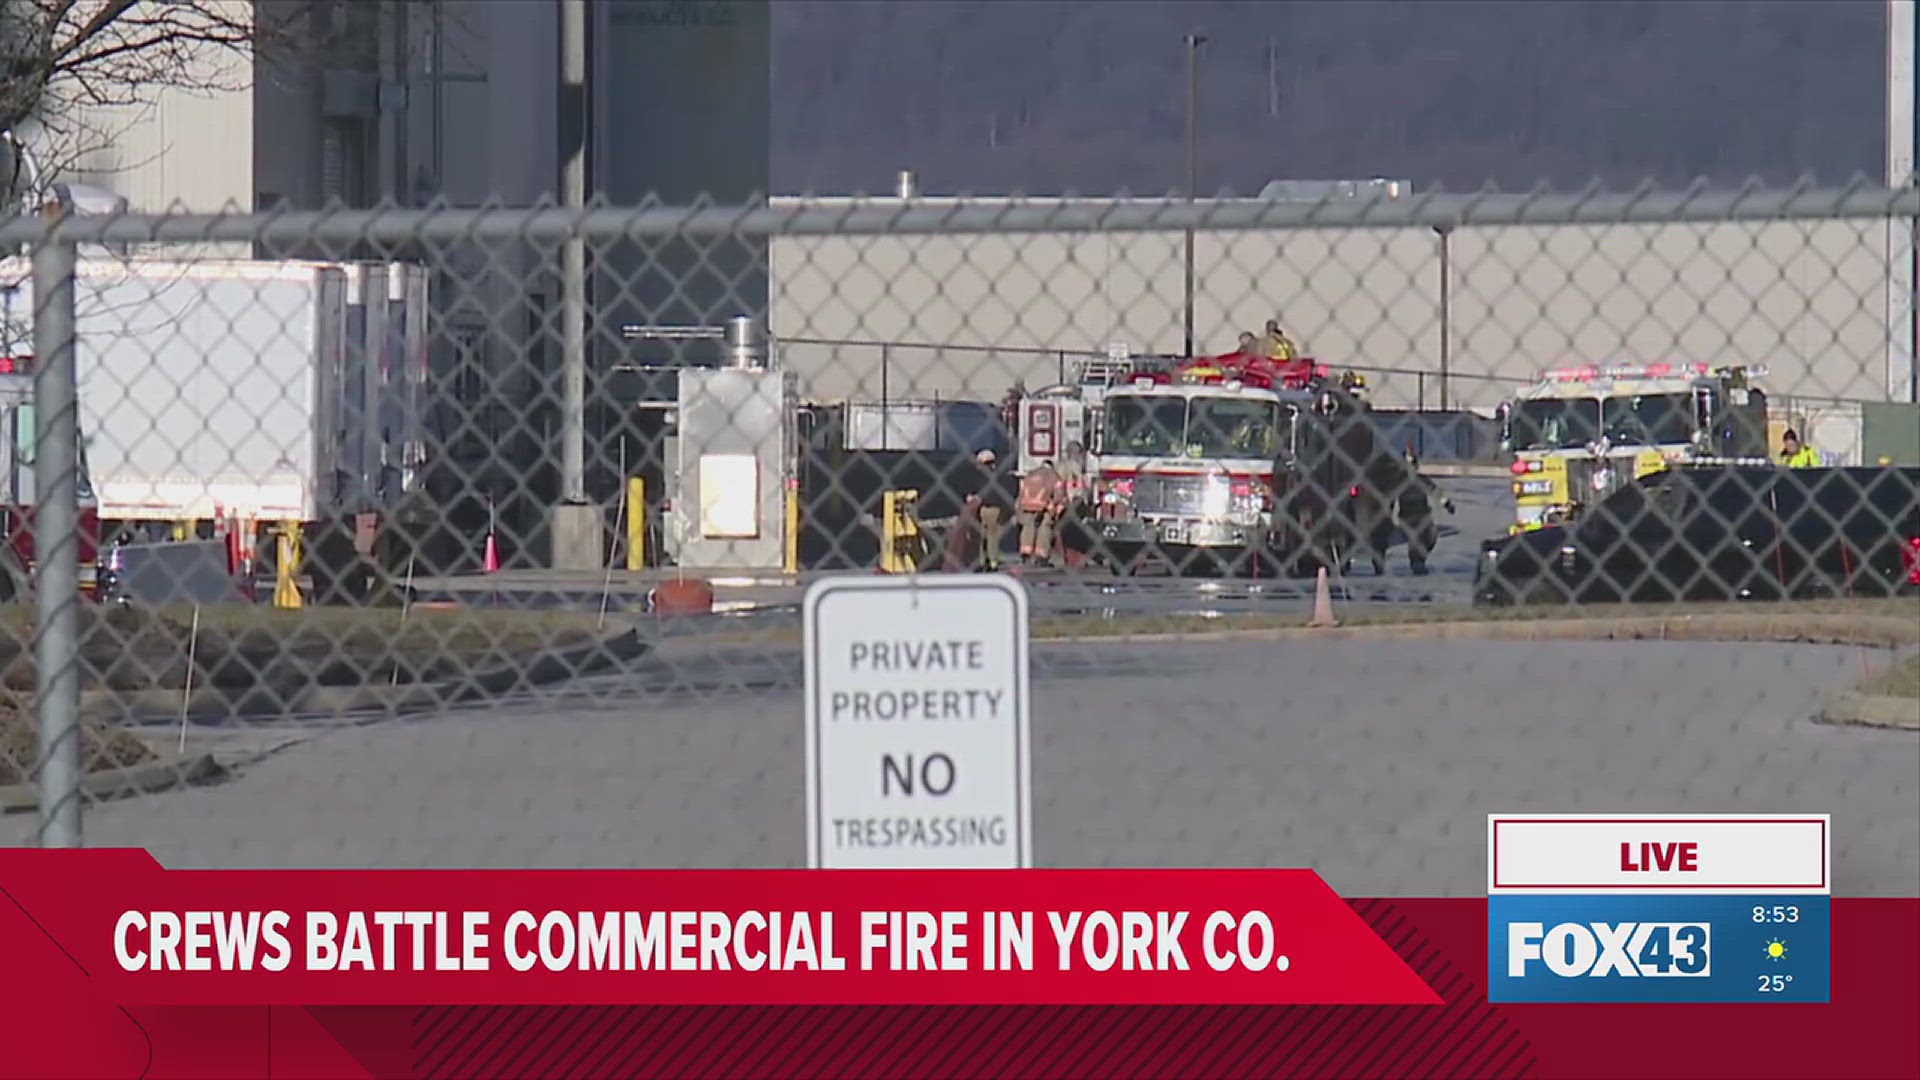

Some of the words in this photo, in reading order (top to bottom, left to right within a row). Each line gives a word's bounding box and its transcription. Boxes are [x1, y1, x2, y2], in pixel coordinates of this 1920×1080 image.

[850, 640, 984, 670] PRIVATE
[832, 689, 1003, 720] PROPERTY
[881, 752, 956, 797] NO
[832, 817, 1007, 848] TRESPASSING
